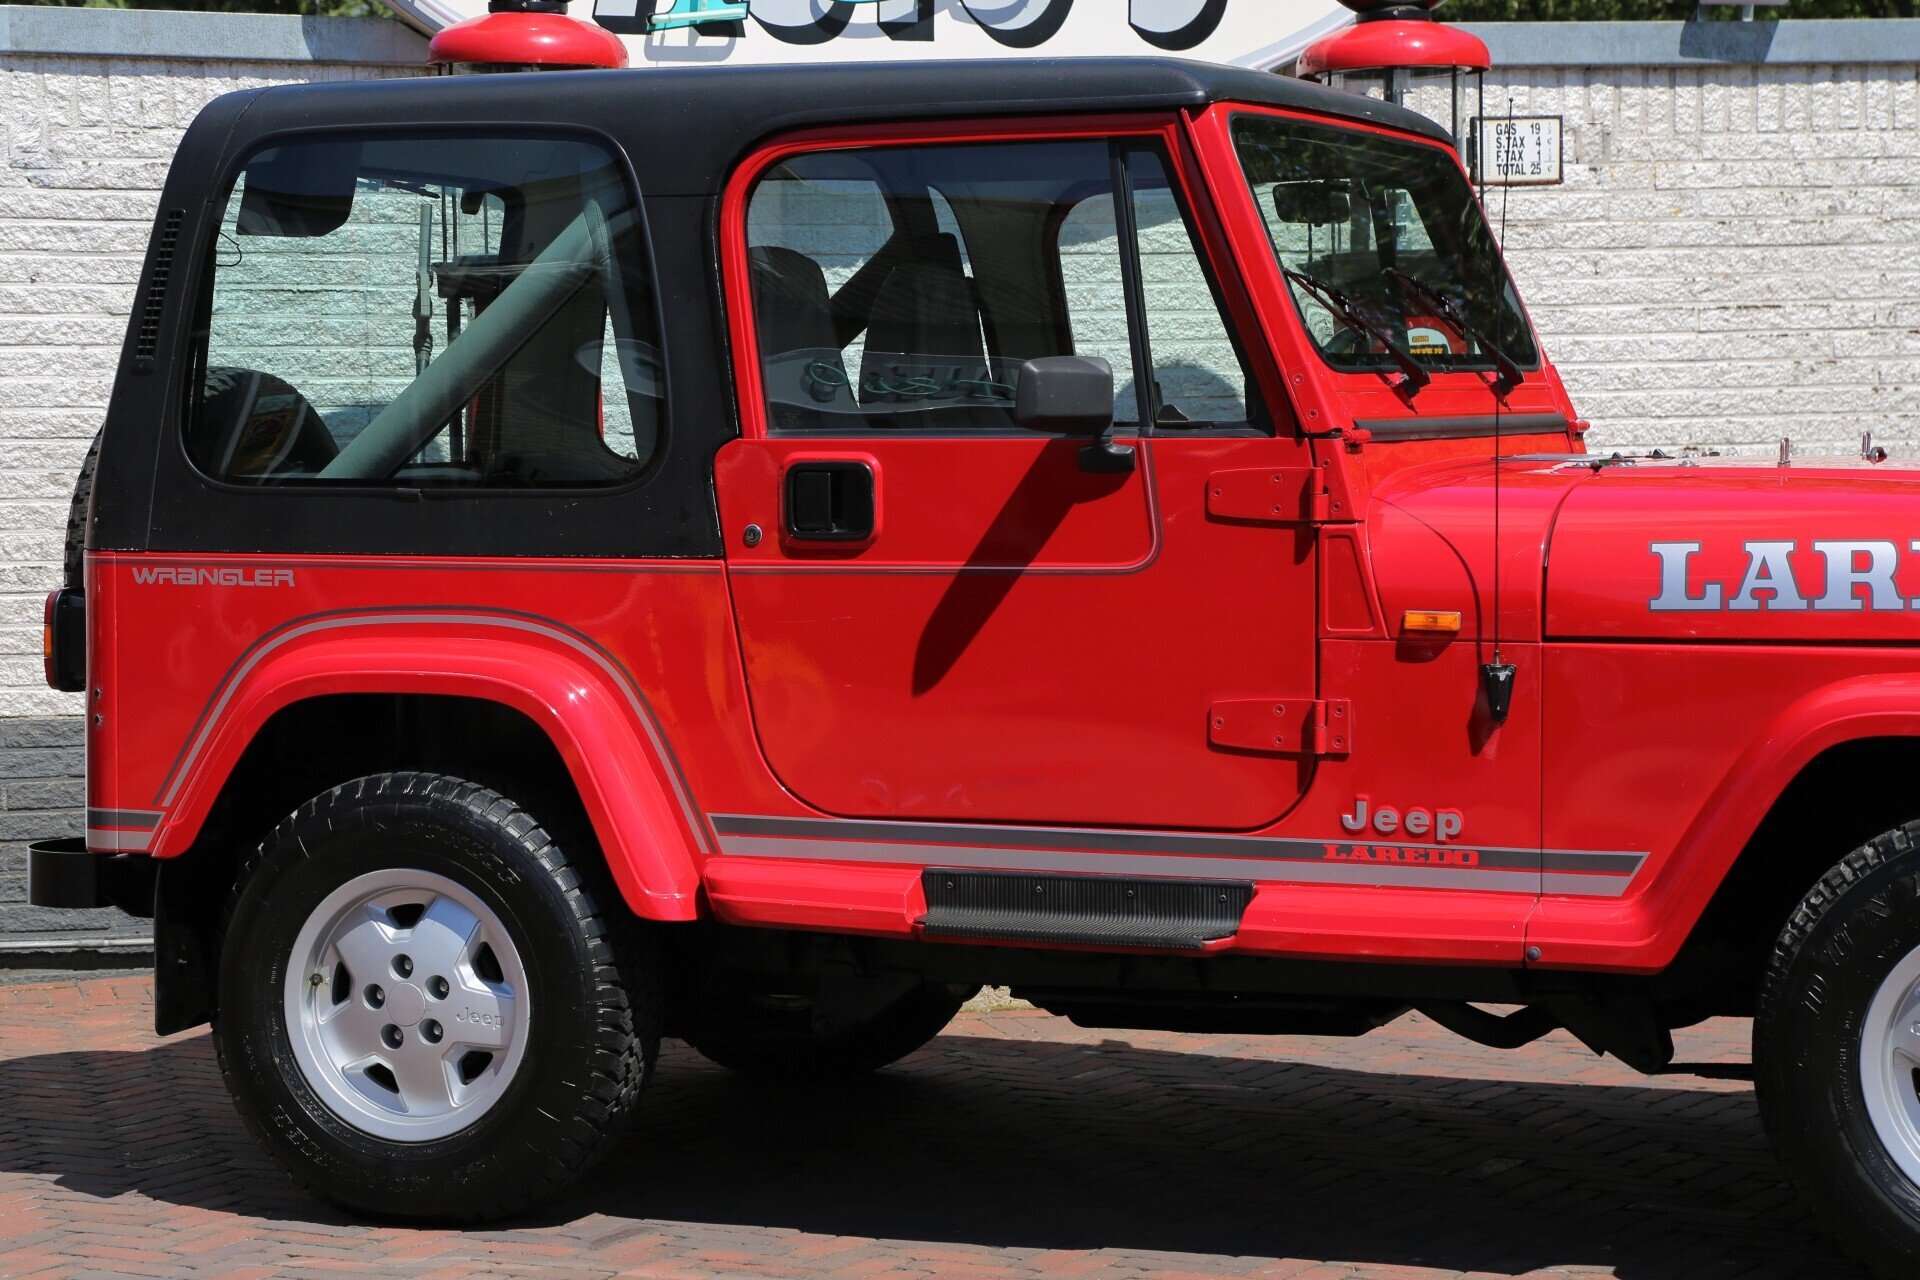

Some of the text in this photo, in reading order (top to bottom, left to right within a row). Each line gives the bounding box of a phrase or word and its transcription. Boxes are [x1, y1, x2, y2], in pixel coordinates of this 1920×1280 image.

[1495, 123, 1517, 136] GAS
[1530, 122, 1541, 135] 19
[1535, 136, 1542, 149] 4
[1496, 163, 1527, 176] TOTAL
[1530, 163, 1542, 176] 25
[131, 567, 296, 588] WRANGLER
[1649, 539, 1920, 612] LAR
[1341, 796, 1464, 844] Jeep
[1322, 843, 1479, 866] LAREDO
[456, 1006, 505, 1031] Jeep
